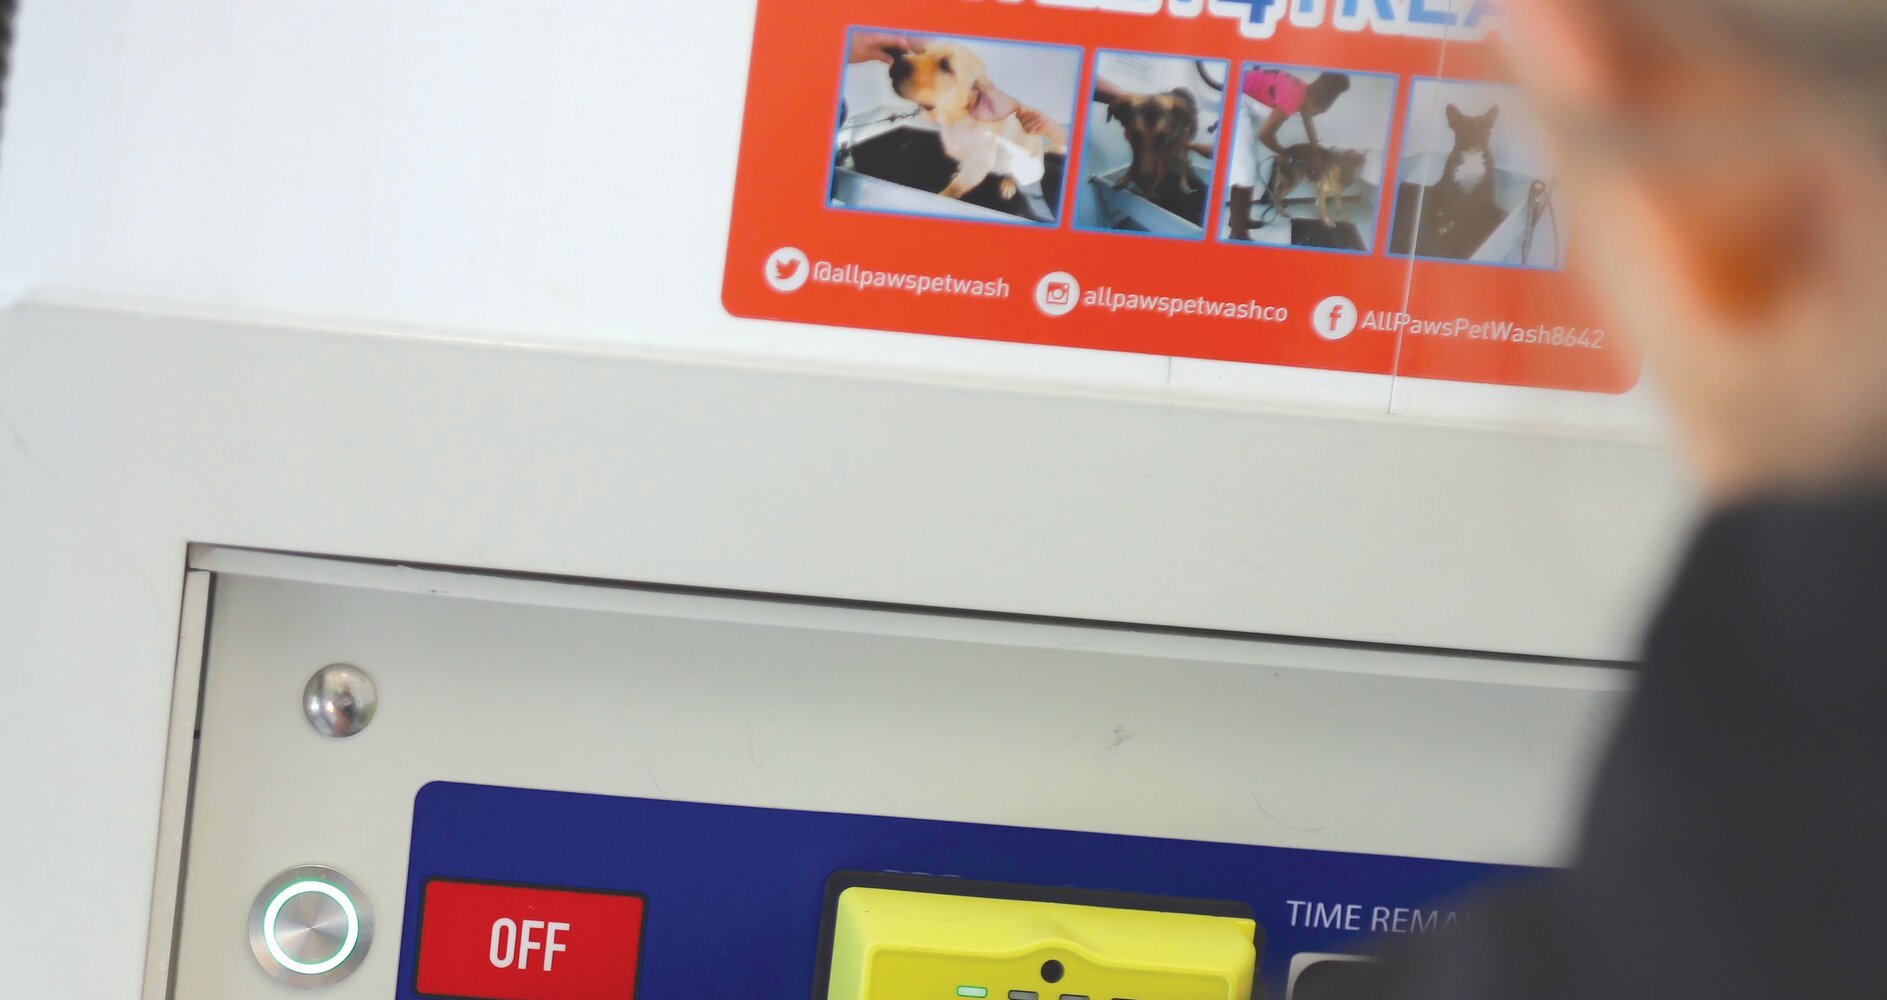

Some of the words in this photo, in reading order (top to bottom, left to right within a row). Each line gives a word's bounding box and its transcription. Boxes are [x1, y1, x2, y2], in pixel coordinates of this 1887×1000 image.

[812, 260, 1010, 298] @allpawspetwash
[1083, 286, 1288, 322] allpawspetwashco
[1360, 308, 1606, 350] AllPawsPetWash8642
[1286, 900, 1363, 931] TIME
[1371, 905, 1470, 935] REMA
[488, 917, 571, 972] OFF
